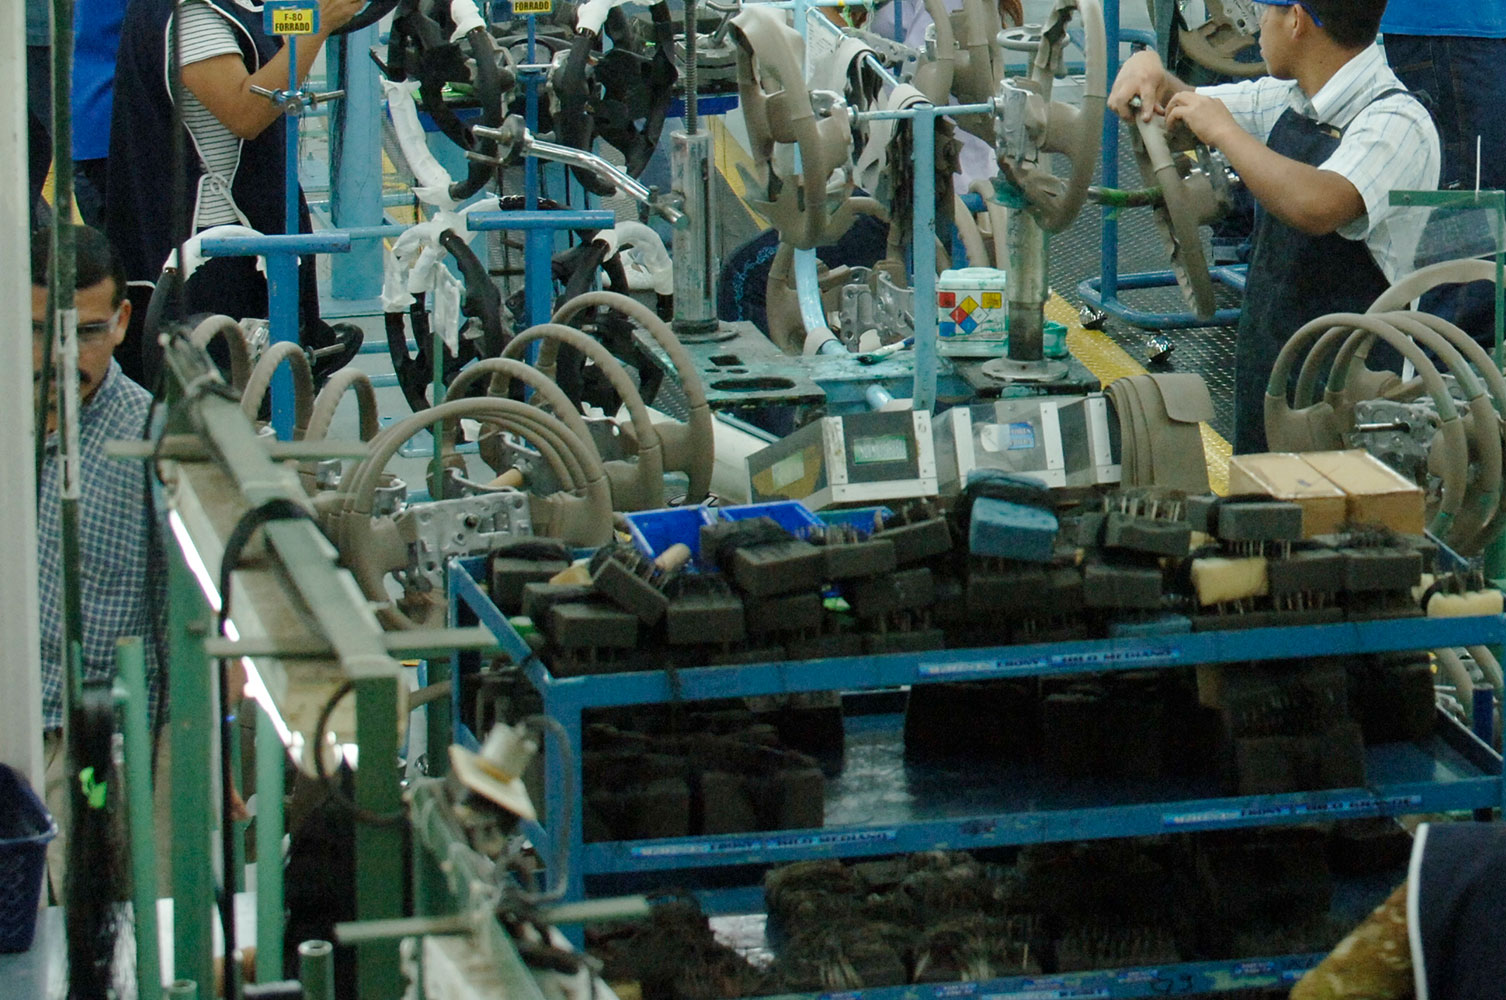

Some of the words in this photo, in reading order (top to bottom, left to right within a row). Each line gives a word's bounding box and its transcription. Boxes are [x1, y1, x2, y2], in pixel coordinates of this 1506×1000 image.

[514, 0, 550, 11] FORRADO
[284, 13, 303, 21] F-80
[275, 22, 310, 32] FORRADO
